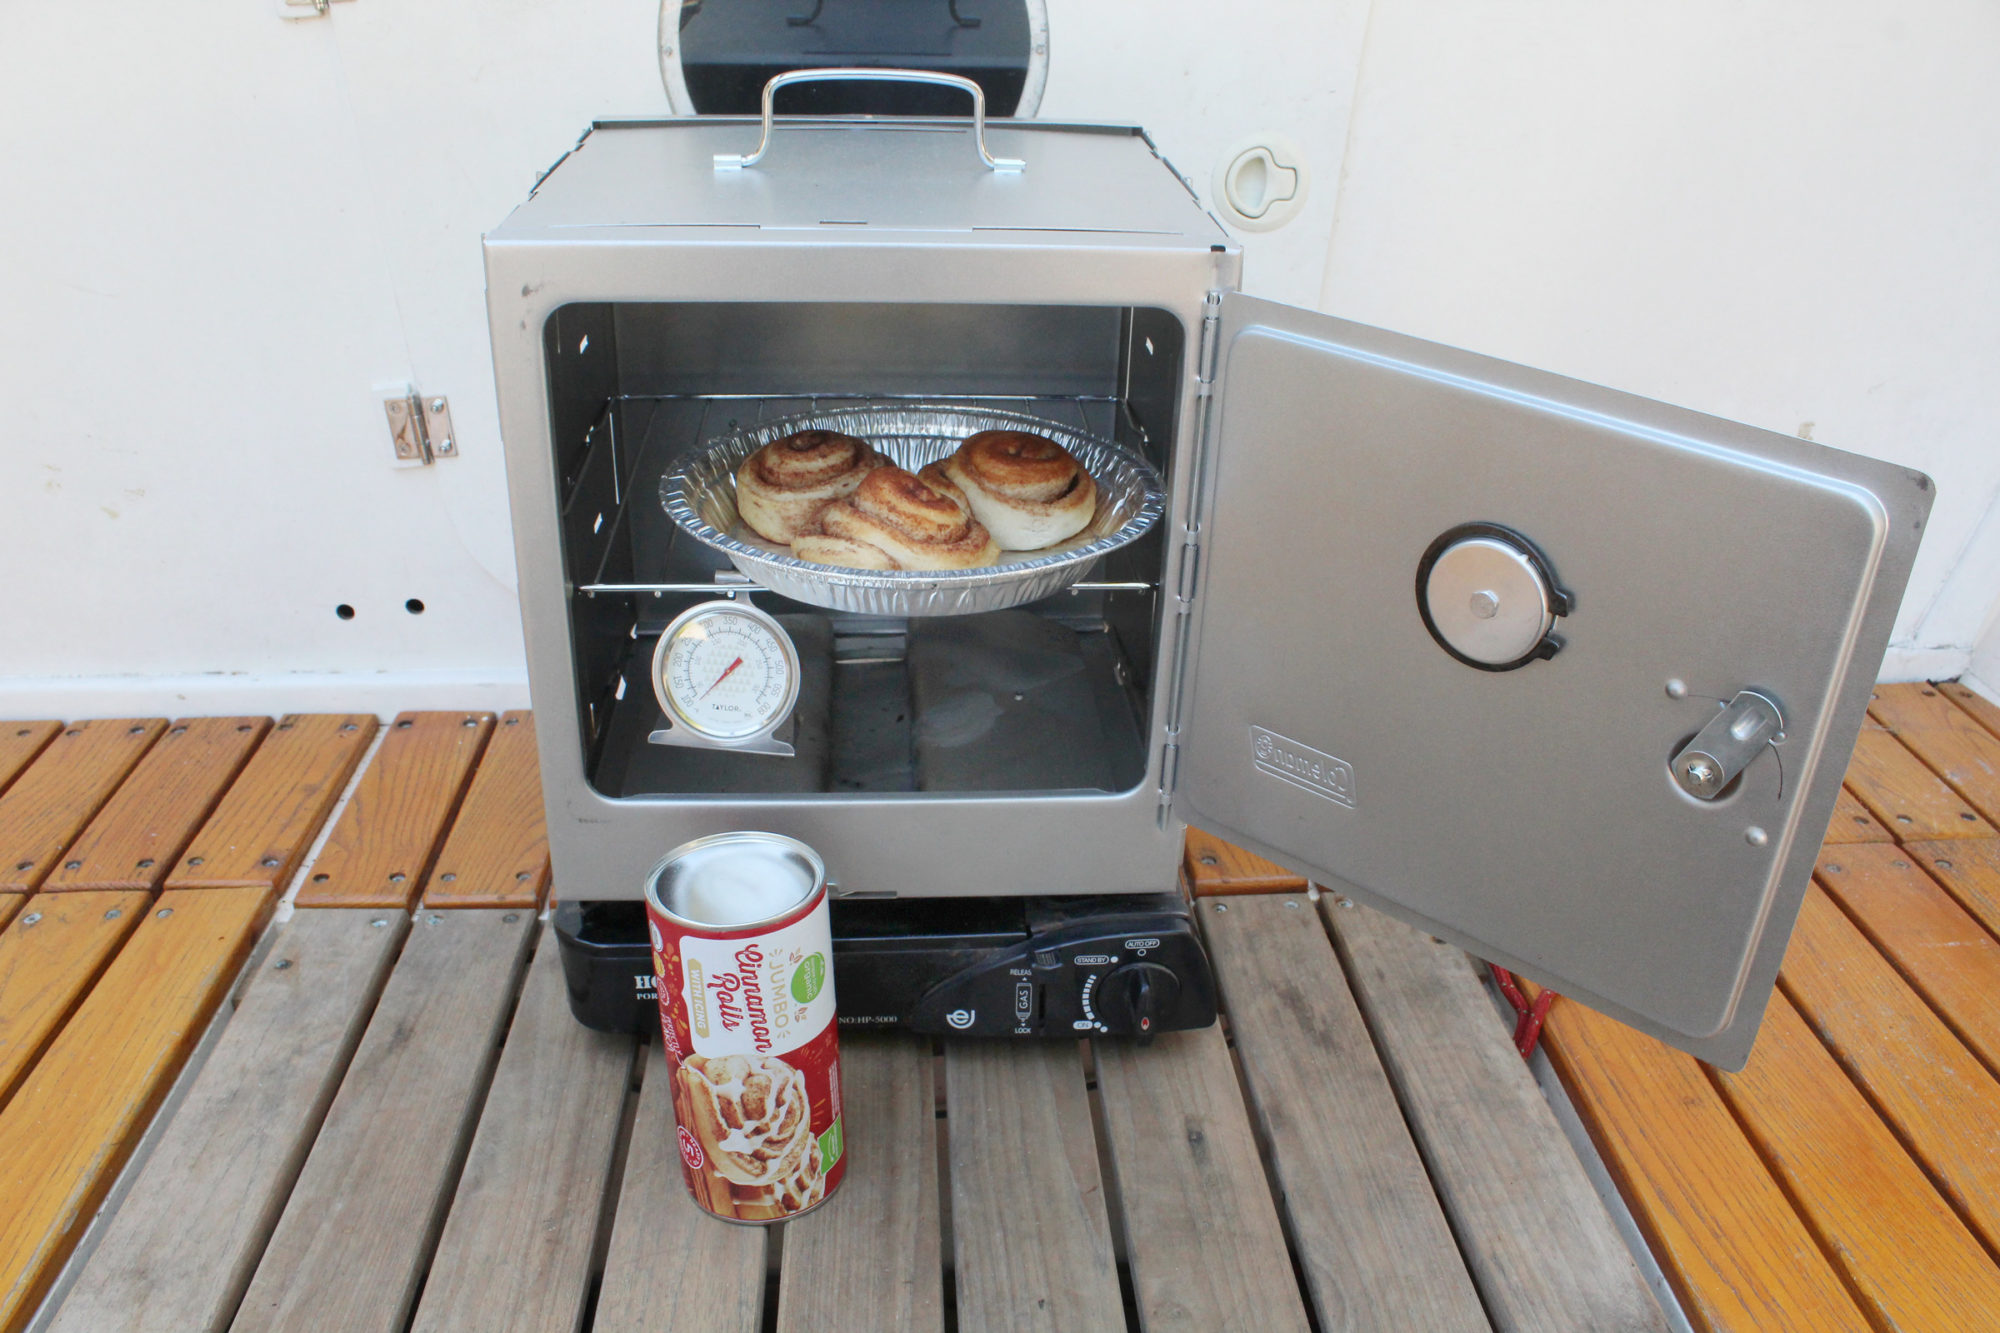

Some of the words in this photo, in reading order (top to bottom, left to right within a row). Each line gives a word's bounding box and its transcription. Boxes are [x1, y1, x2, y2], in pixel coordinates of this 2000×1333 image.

[722, 616, 738, 626] 350
[748, 622, 761, 634] 400
[766, 638, 778, 652] 450
[674, 652, 684, 667] 200
[774, 660, 784, 675] 500
[674, 675, 684, 688] 150
[771, 683, 782, 698] 550
[681, 694, 694, 707] 100
[758, 702, 771, 716] 600
[690, 968, 703, 998] WITH
[706, 972, 744, 1032] Rolls
[734, 943, 773, 1053] Cinnamon
[769, 961, 789, 1029] JUMBO
[1018, 990, 1029, 1009] GAS
[695, 999, 706, 1029] ICING
